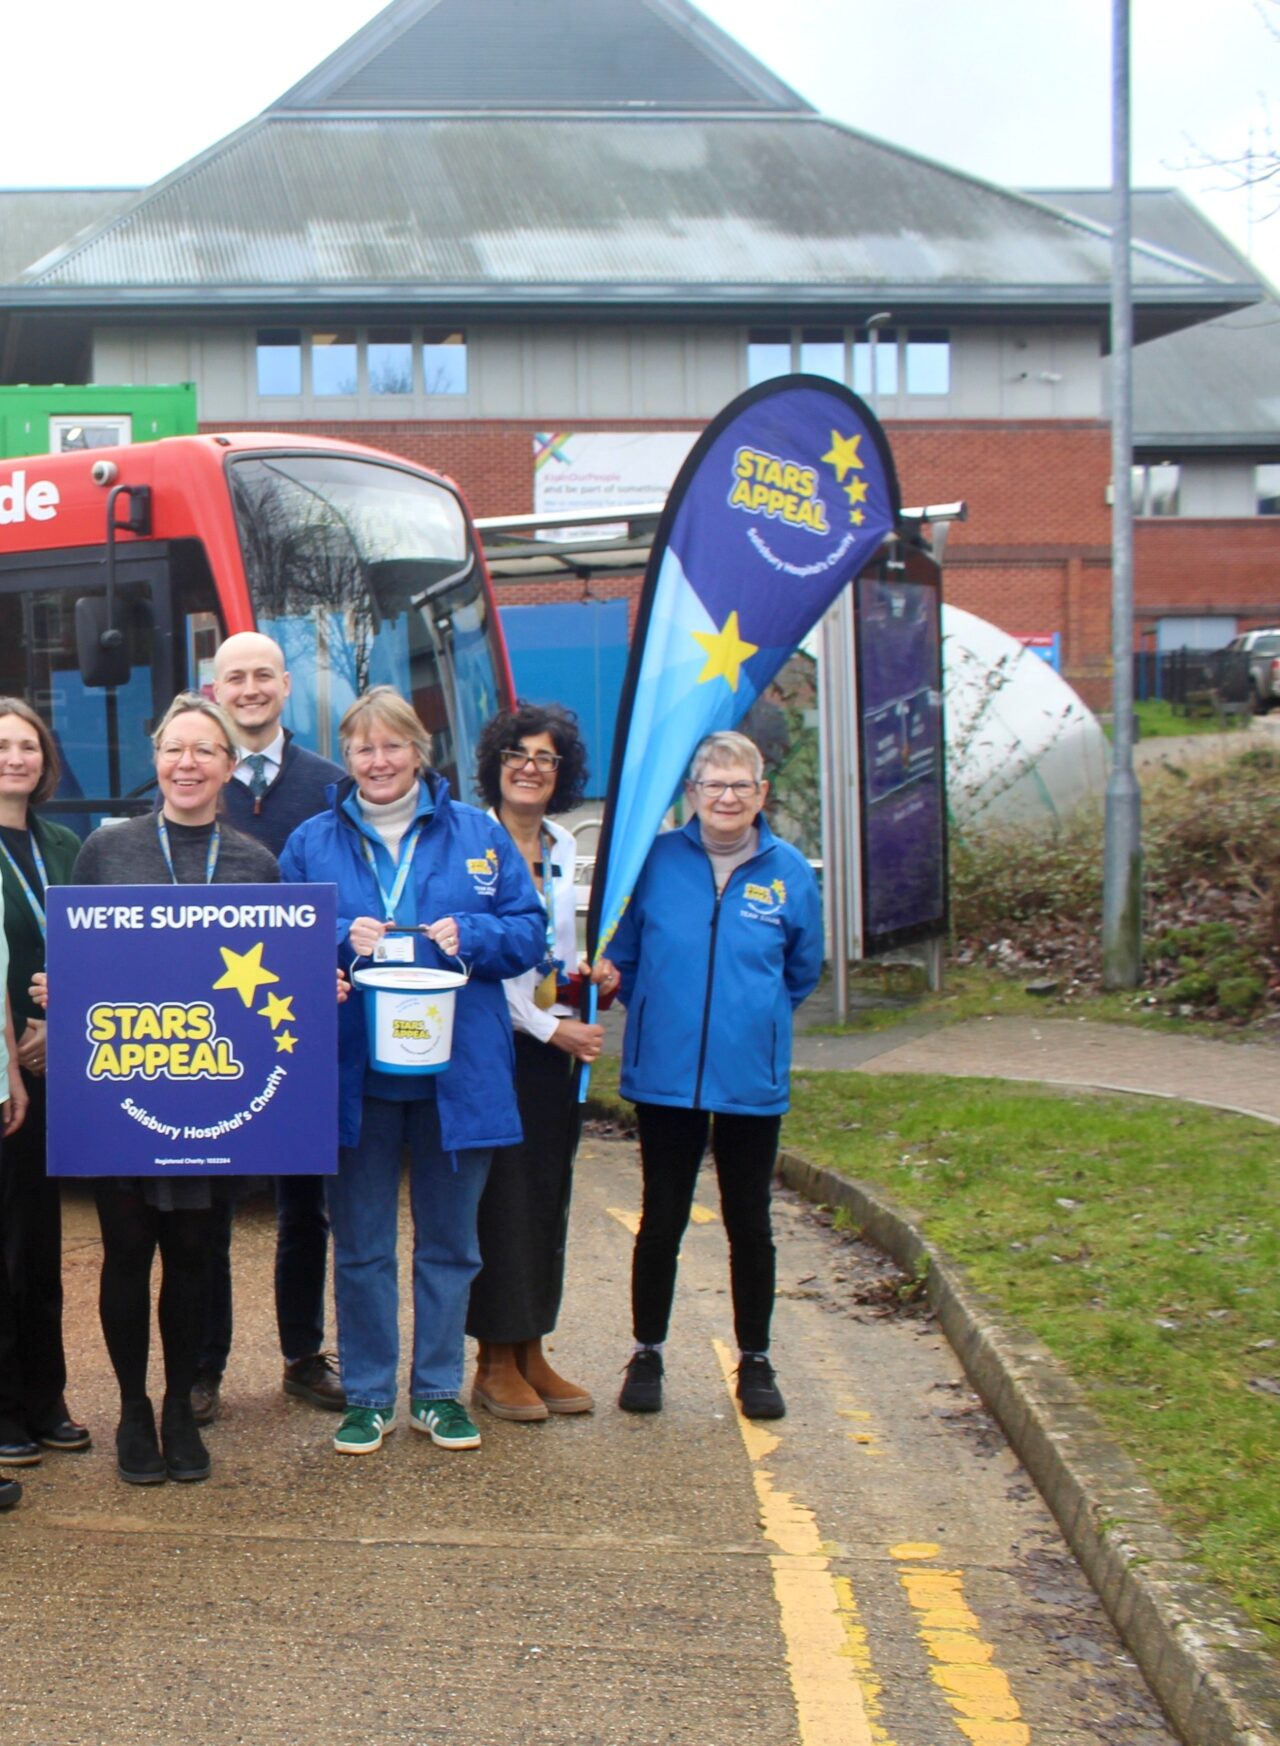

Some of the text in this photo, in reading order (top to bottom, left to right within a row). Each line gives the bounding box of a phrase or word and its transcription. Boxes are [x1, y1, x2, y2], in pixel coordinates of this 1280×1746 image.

[736, 450, 816, 498] STARS
[731, 479, 827, 531] APPEAL
[66, 904, 318, 929] WE'RE SUPPORTING
[90, 1005, 214, 1041] STARS
[89, 1042, 240, 1076] APPEAL
[120, 1065, 288, 1140] Salisbury Hospital's Charity
